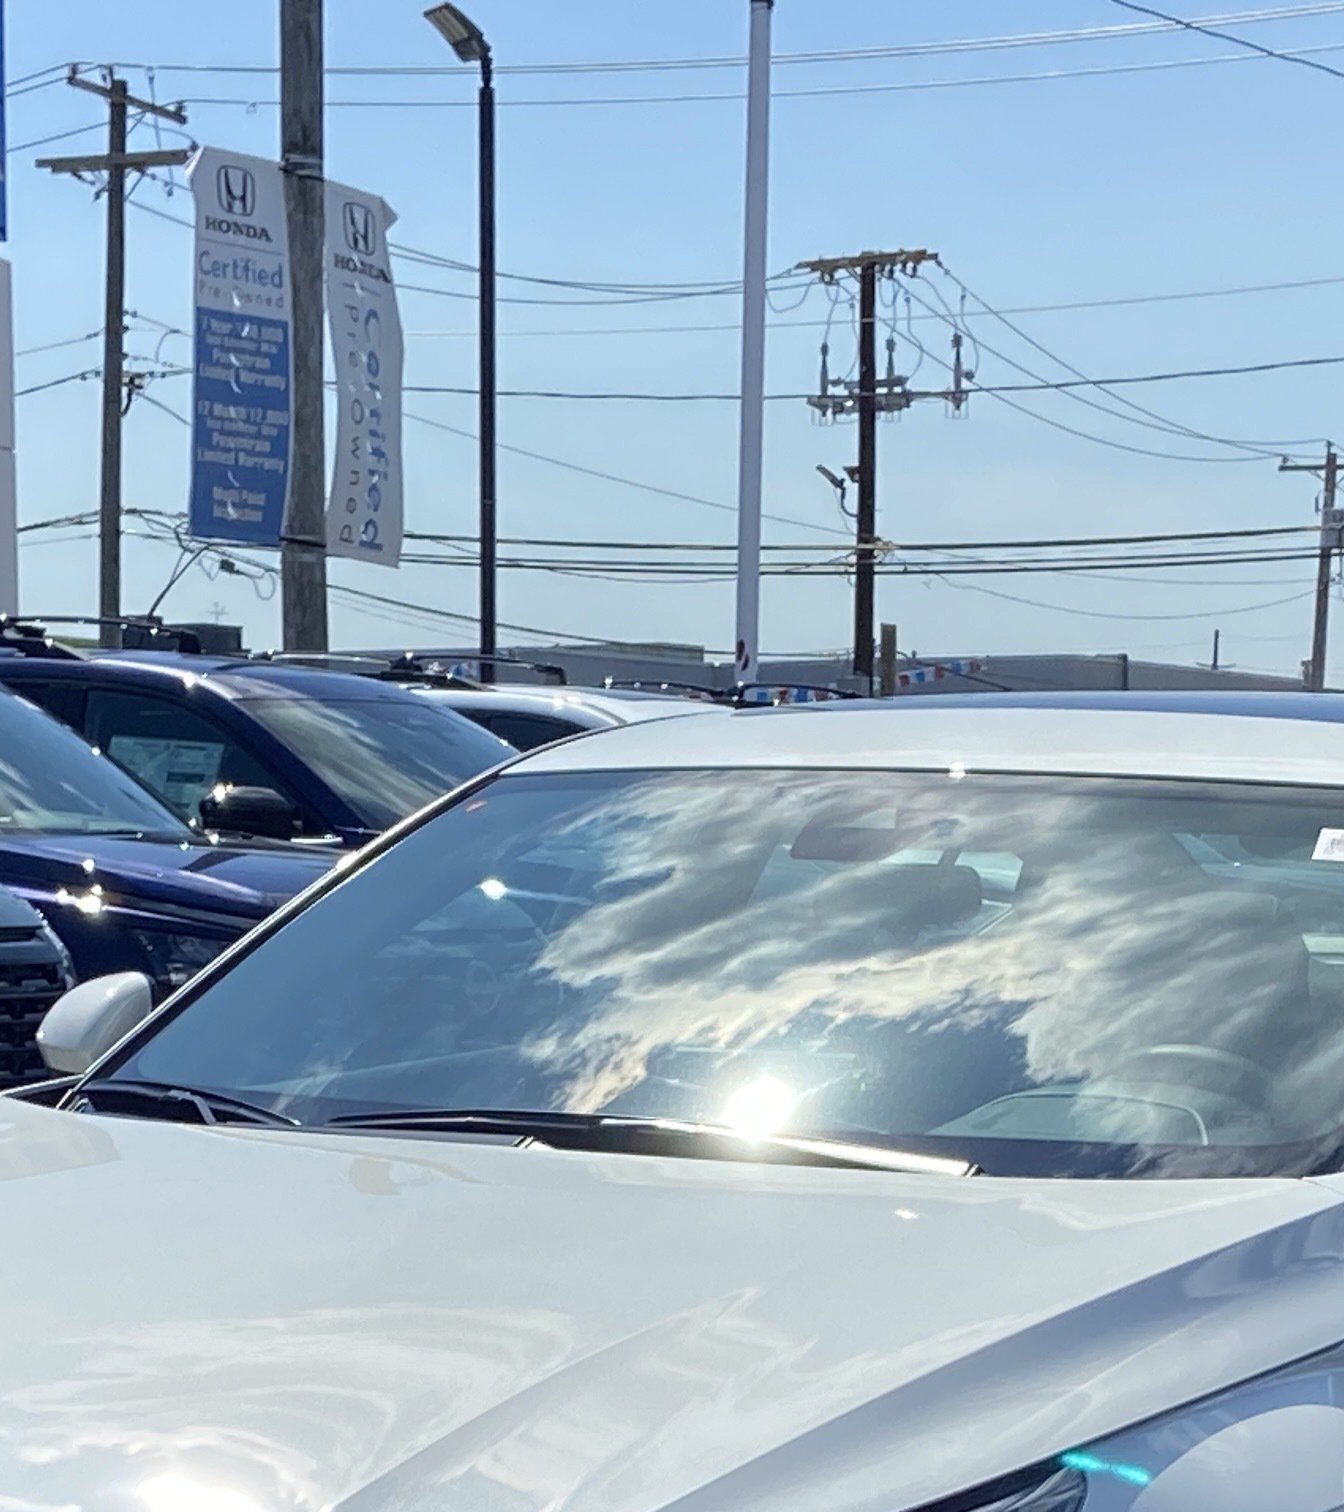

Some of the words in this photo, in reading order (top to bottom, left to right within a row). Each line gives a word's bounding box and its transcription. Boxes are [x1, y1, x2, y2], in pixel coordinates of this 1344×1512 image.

[205, 216, 273, 242] HONDA
[199, 250, 283, 288] Certified
[359, 308, 389, 551] Certified
